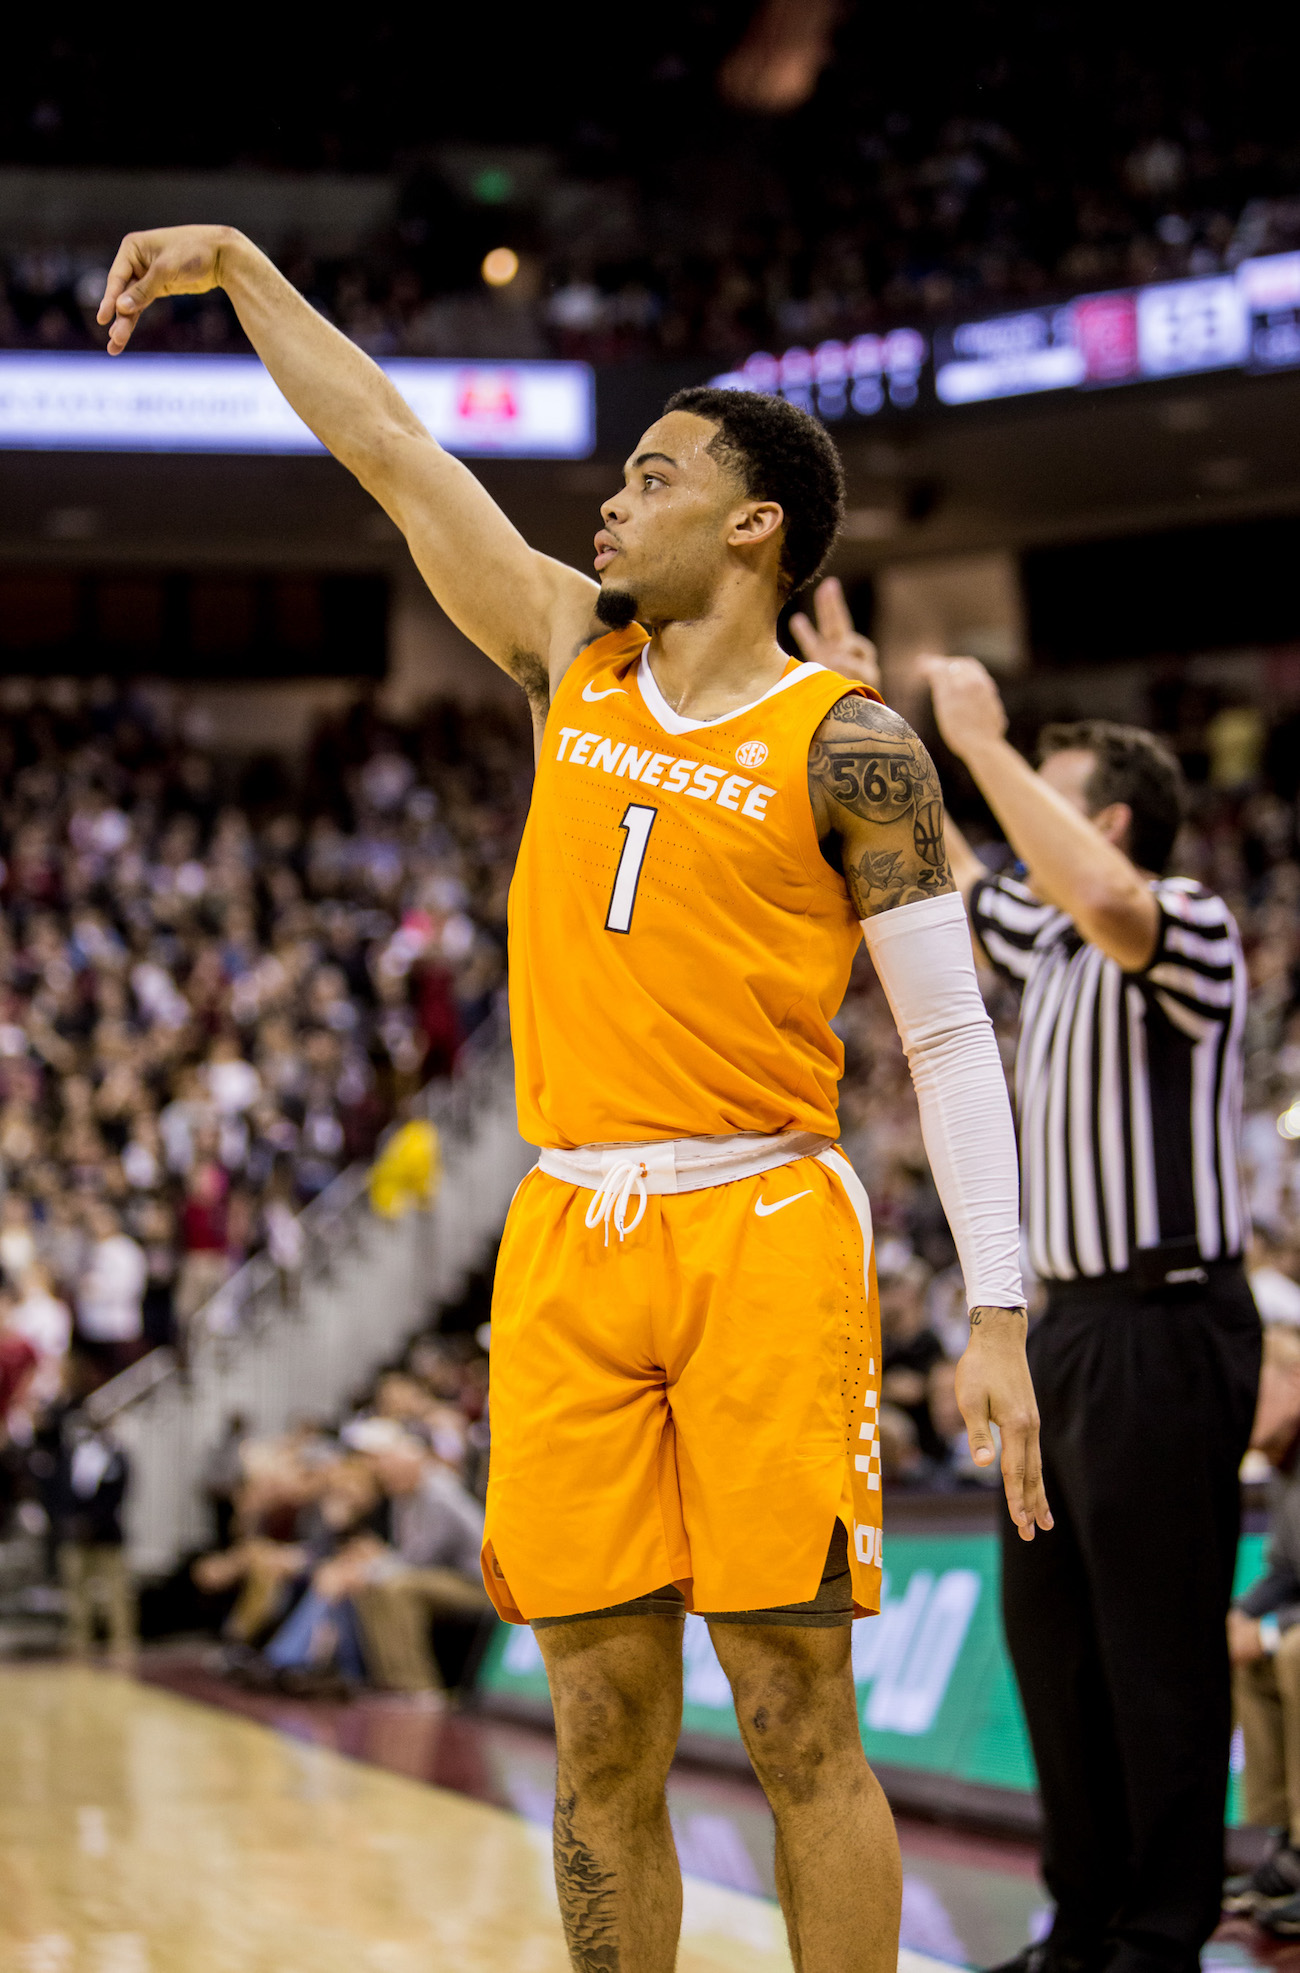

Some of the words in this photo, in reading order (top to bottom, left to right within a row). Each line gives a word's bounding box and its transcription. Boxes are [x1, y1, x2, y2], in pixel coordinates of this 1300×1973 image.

[556, 727, 778, 822] TENNESSEE
[737, 742, 767, 767] SEC
[833, 759, 913, 803] 565
[604, 802, 658, 935] 1
